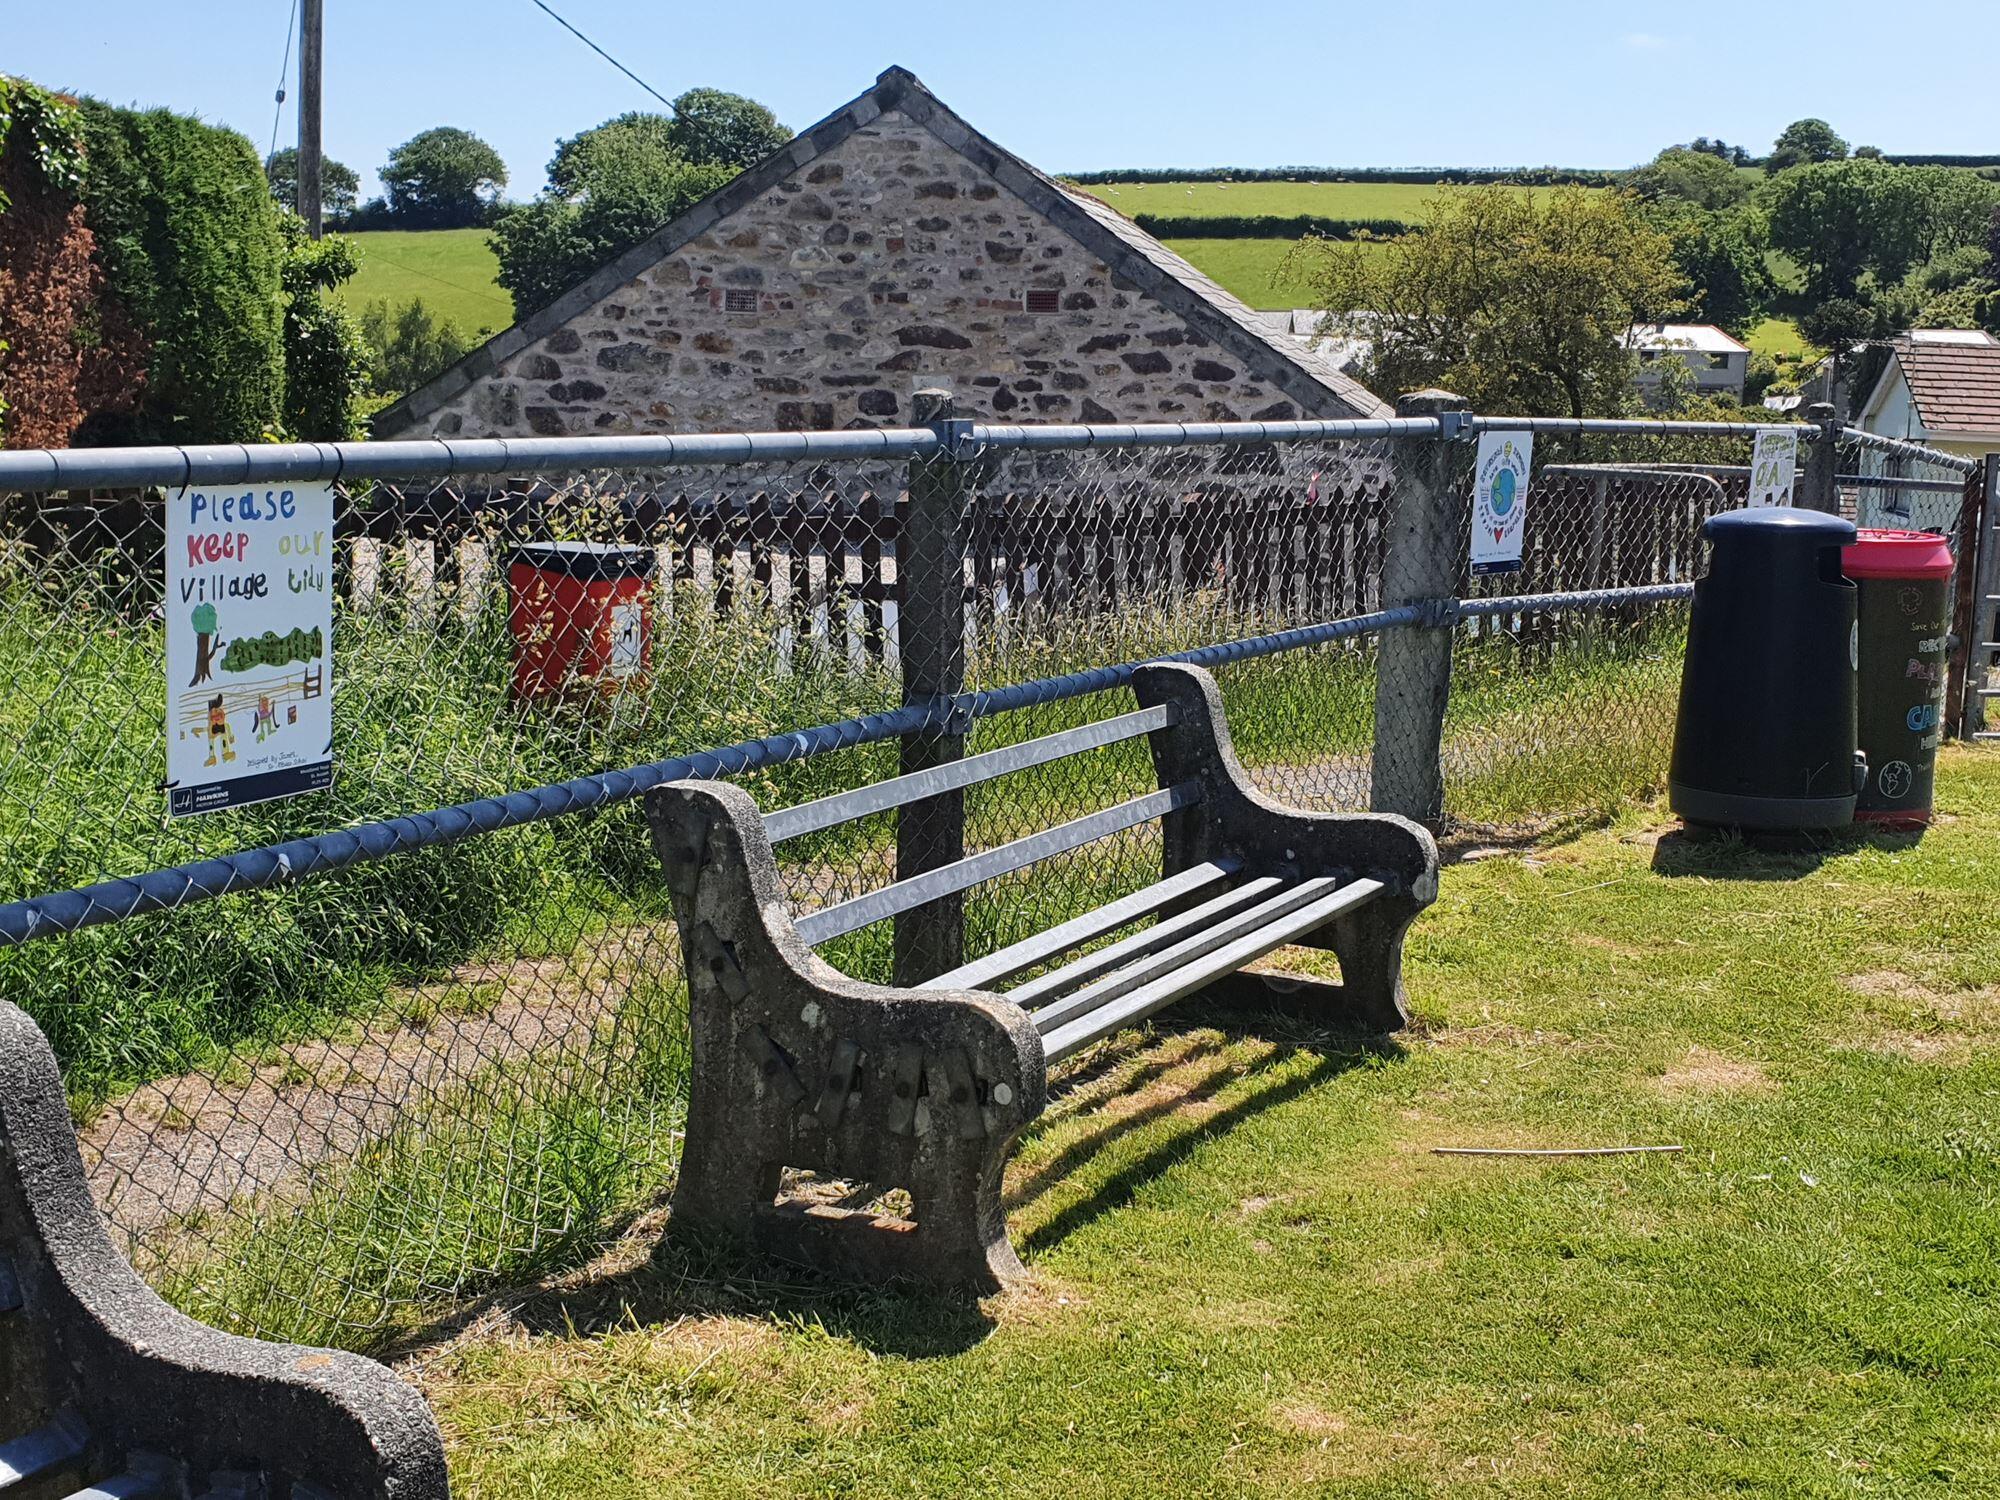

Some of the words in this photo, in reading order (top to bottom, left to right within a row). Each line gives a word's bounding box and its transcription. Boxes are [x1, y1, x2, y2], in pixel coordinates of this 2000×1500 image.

[191, 490, 295, 524] Please
[278, 531, 324, 556] our
[180, 572, 268, 604] Village
[288, 564, 323, 594] tidy
